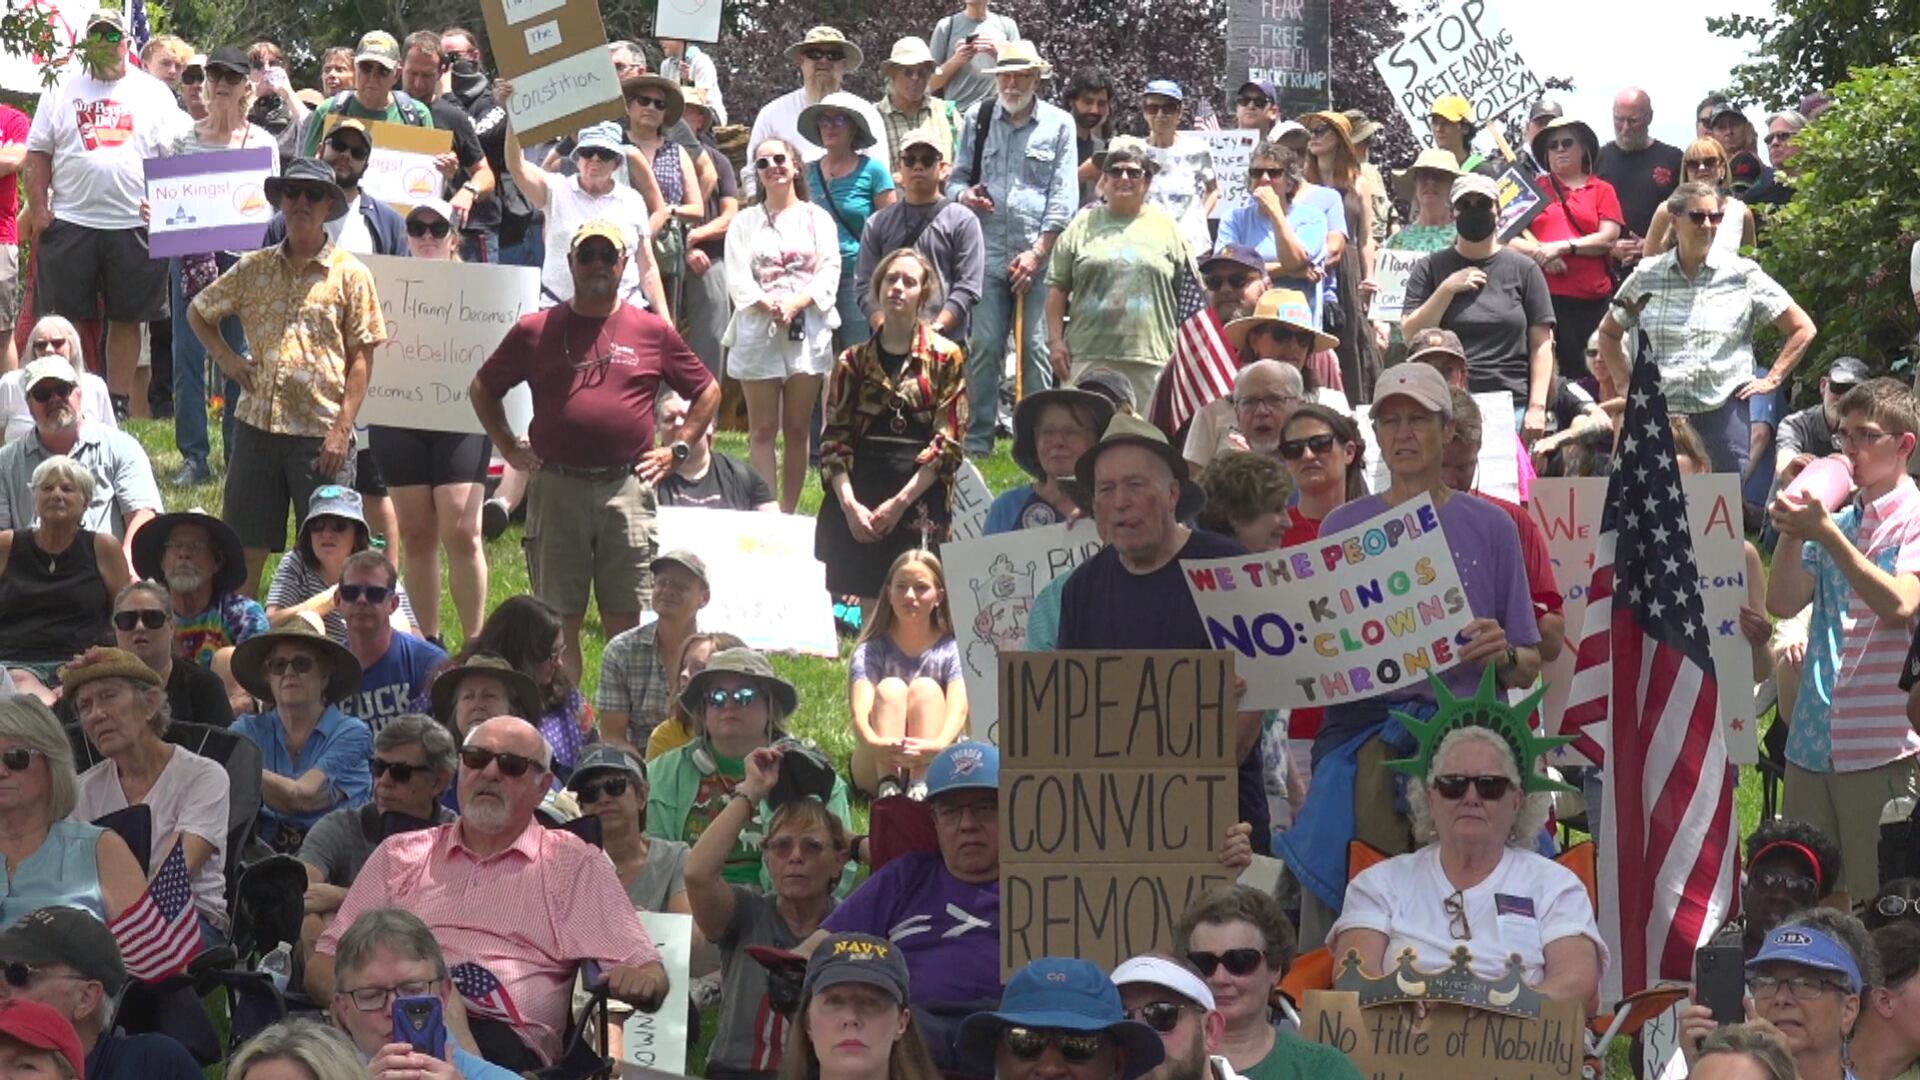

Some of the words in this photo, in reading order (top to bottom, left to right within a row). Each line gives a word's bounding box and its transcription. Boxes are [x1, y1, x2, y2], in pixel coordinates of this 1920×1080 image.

[1261, 0, 1304, 21] FEAR
[1248, 46, 1310, 72] SPEECH
[1260, 24, 1304, 48] FREE
[1388, 0, 1485, 90] STOP
[1402, 28, 1513, 117] PRETENDING
[370, 158, 404, 174] ngs!
[156, 186, 178, 200] No
[182, 180, 230, 199] Kings!
[367, 380, 424, 403] ecomes
[1704, 494, 1736, 540] A
[1187, 567, 1237, 592] WE
[1242, 552, 1315, 588] THE
[1320, 504, 1439, 572] PEOPLE
[1206, 612, 1308, 659] NO:
[1313, 586, 1465, 658] CLOWNS
[1007, 656, 1225, 758] IMPEACH
[1008, 772, 1227, 854] CONVICT
[1006, 873, 1228, 968] REMOV
[832, 941, 889, 958] NAVY
[1318, 1009, 1357, 1055] No
[1371, 1011, 1430, 1055] title
[1445, 1017, 1470, 1057] of
[1482, 1015, 1575, 1076] Nobility
